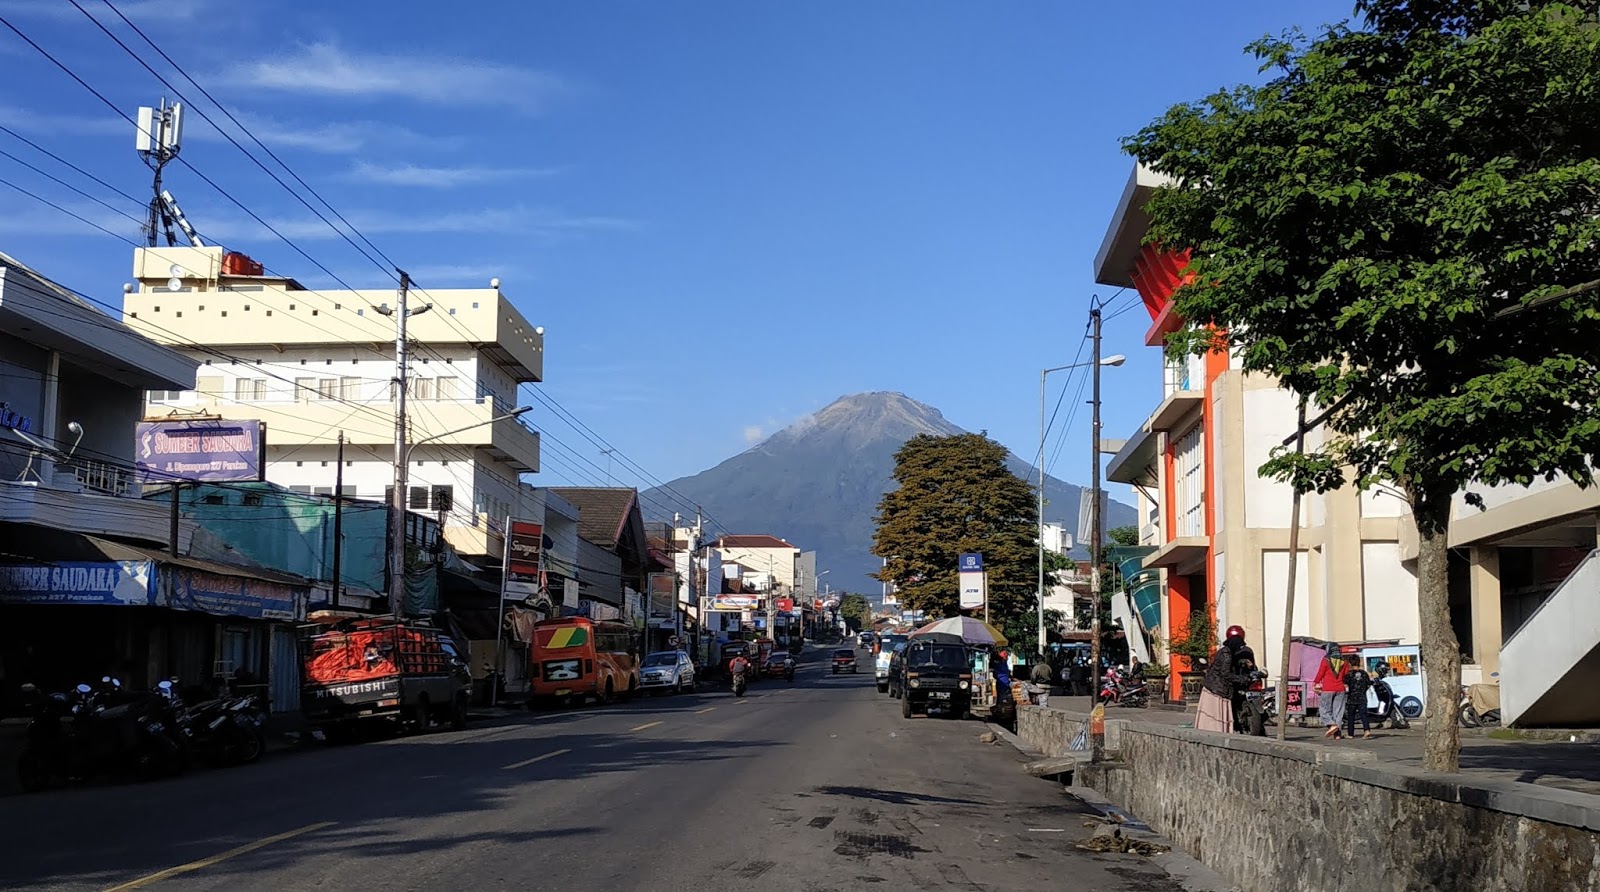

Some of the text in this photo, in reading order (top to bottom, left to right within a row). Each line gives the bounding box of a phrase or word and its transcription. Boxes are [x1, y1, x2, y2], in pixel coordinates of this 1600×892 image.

[155, 430, 253, 454] SUMBER SAUDARA
[174, 462, 210, 473] Diponegoro
[210, 461, 222, 470] 227
[223, 460, 247, 470] Parakan
[0, 567, 115, 592] SUMBER SAUDARA
[316, 681, 386, 698] MITSUBISHI
